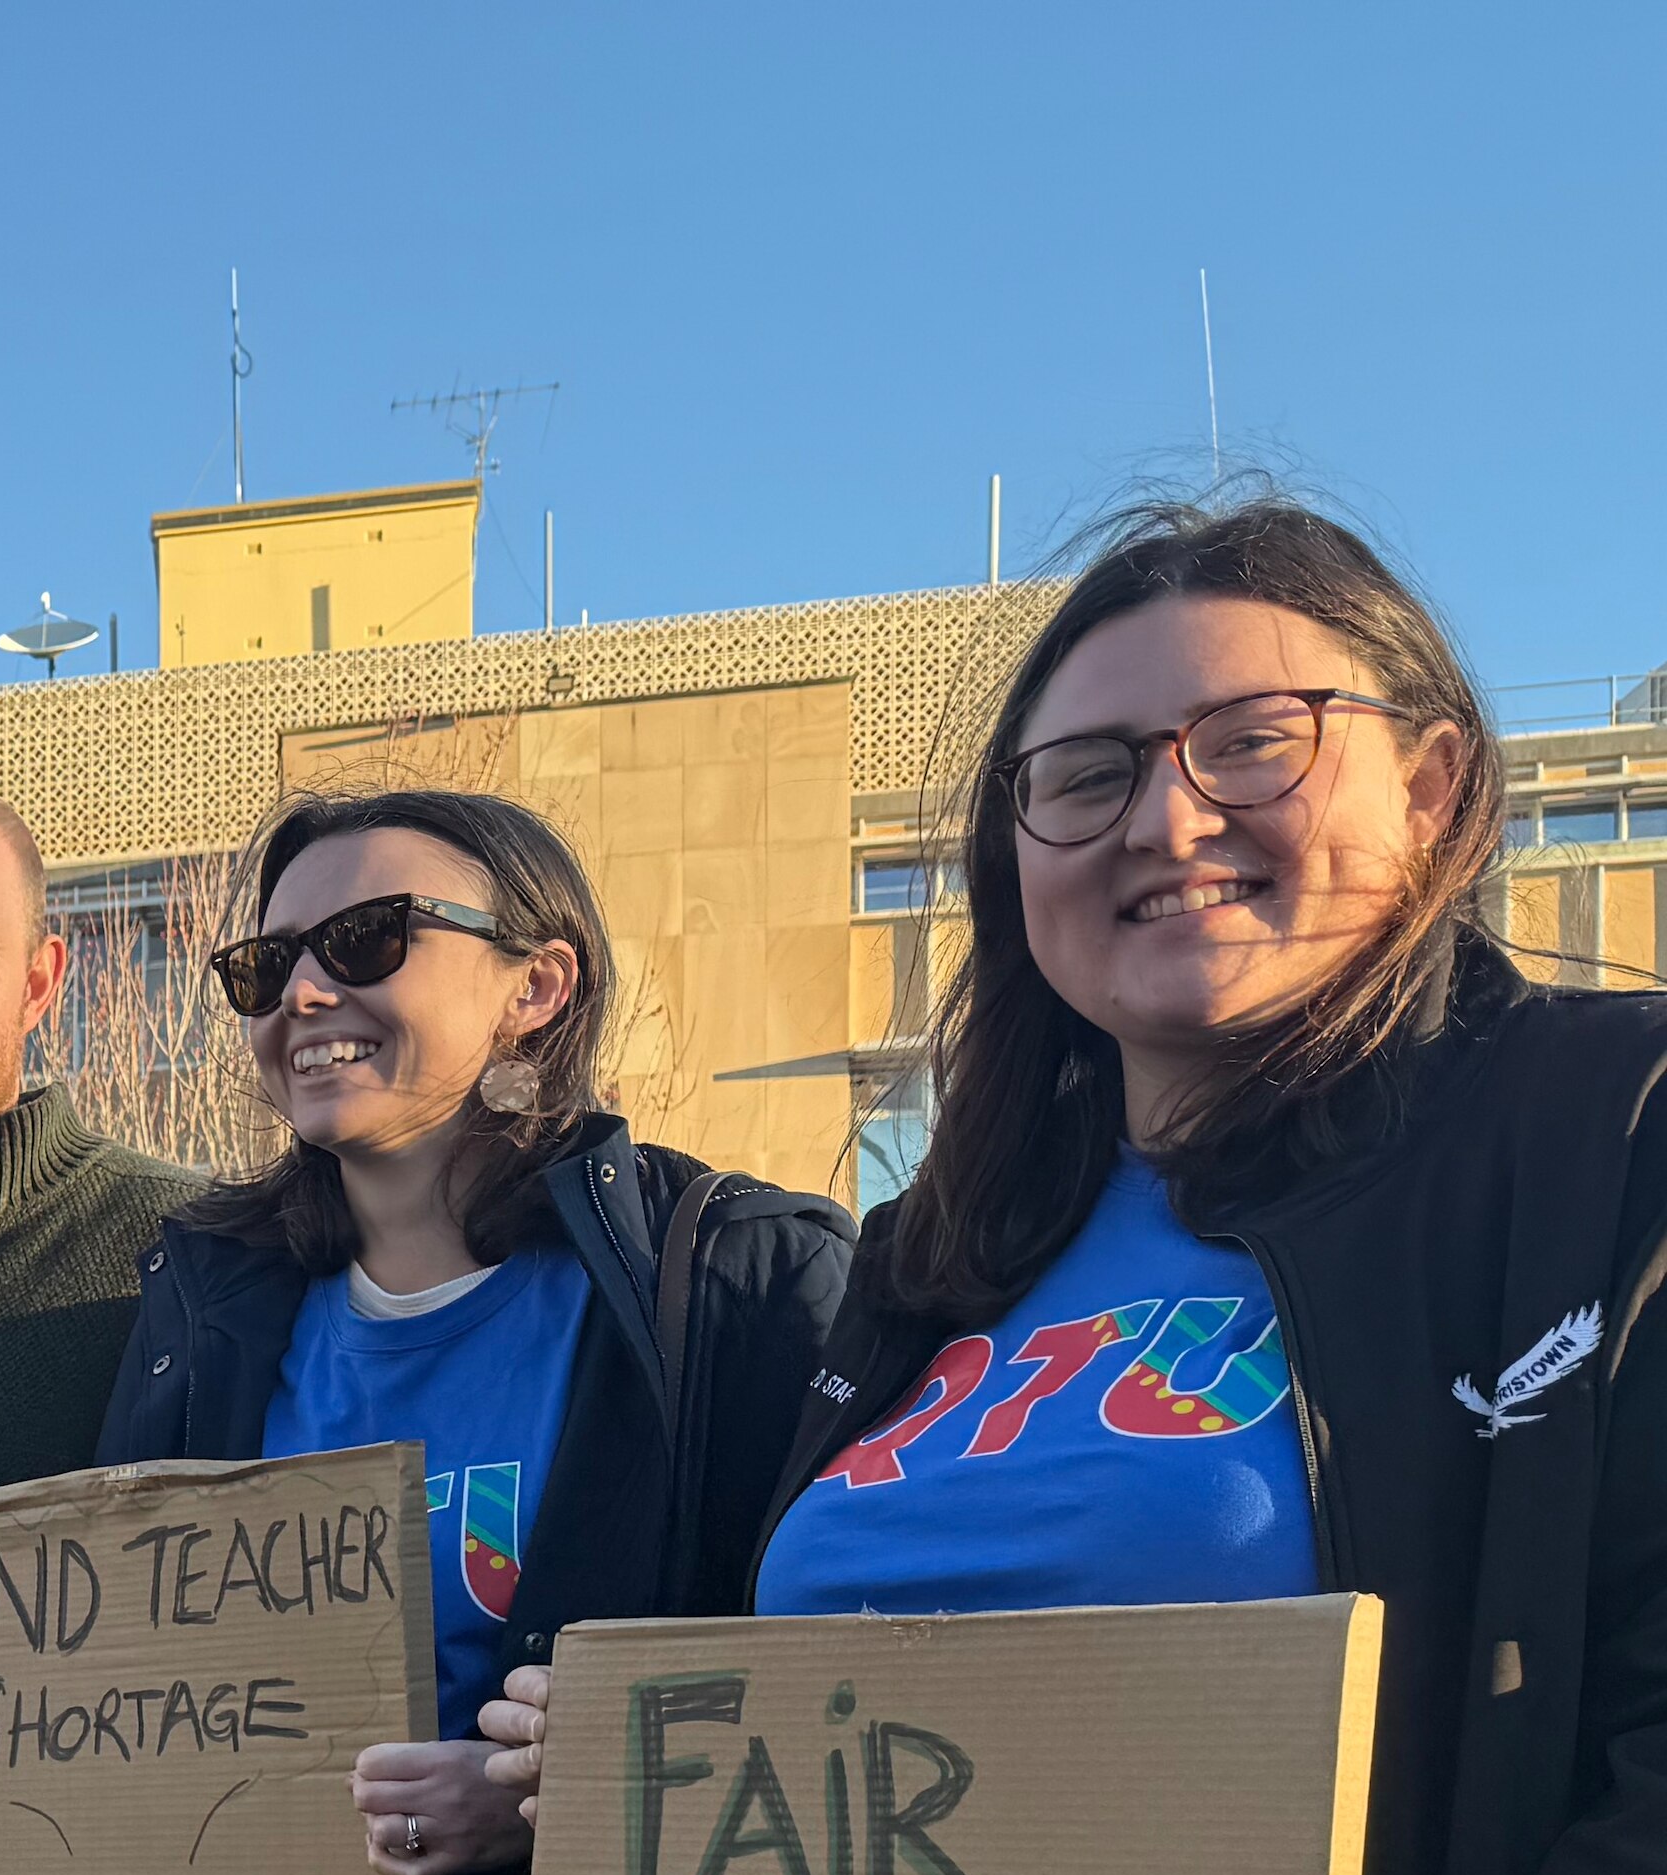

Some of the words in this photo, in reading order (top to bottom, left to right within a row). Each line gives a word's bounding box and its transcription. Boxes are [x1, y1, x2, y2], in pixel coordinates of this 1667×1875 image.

[815, 1297, 1292, 1490] QTU
[1491, 1334, 1577, 1406] RISTOWN
[121, 1504, 397, 1630] TEACHER
